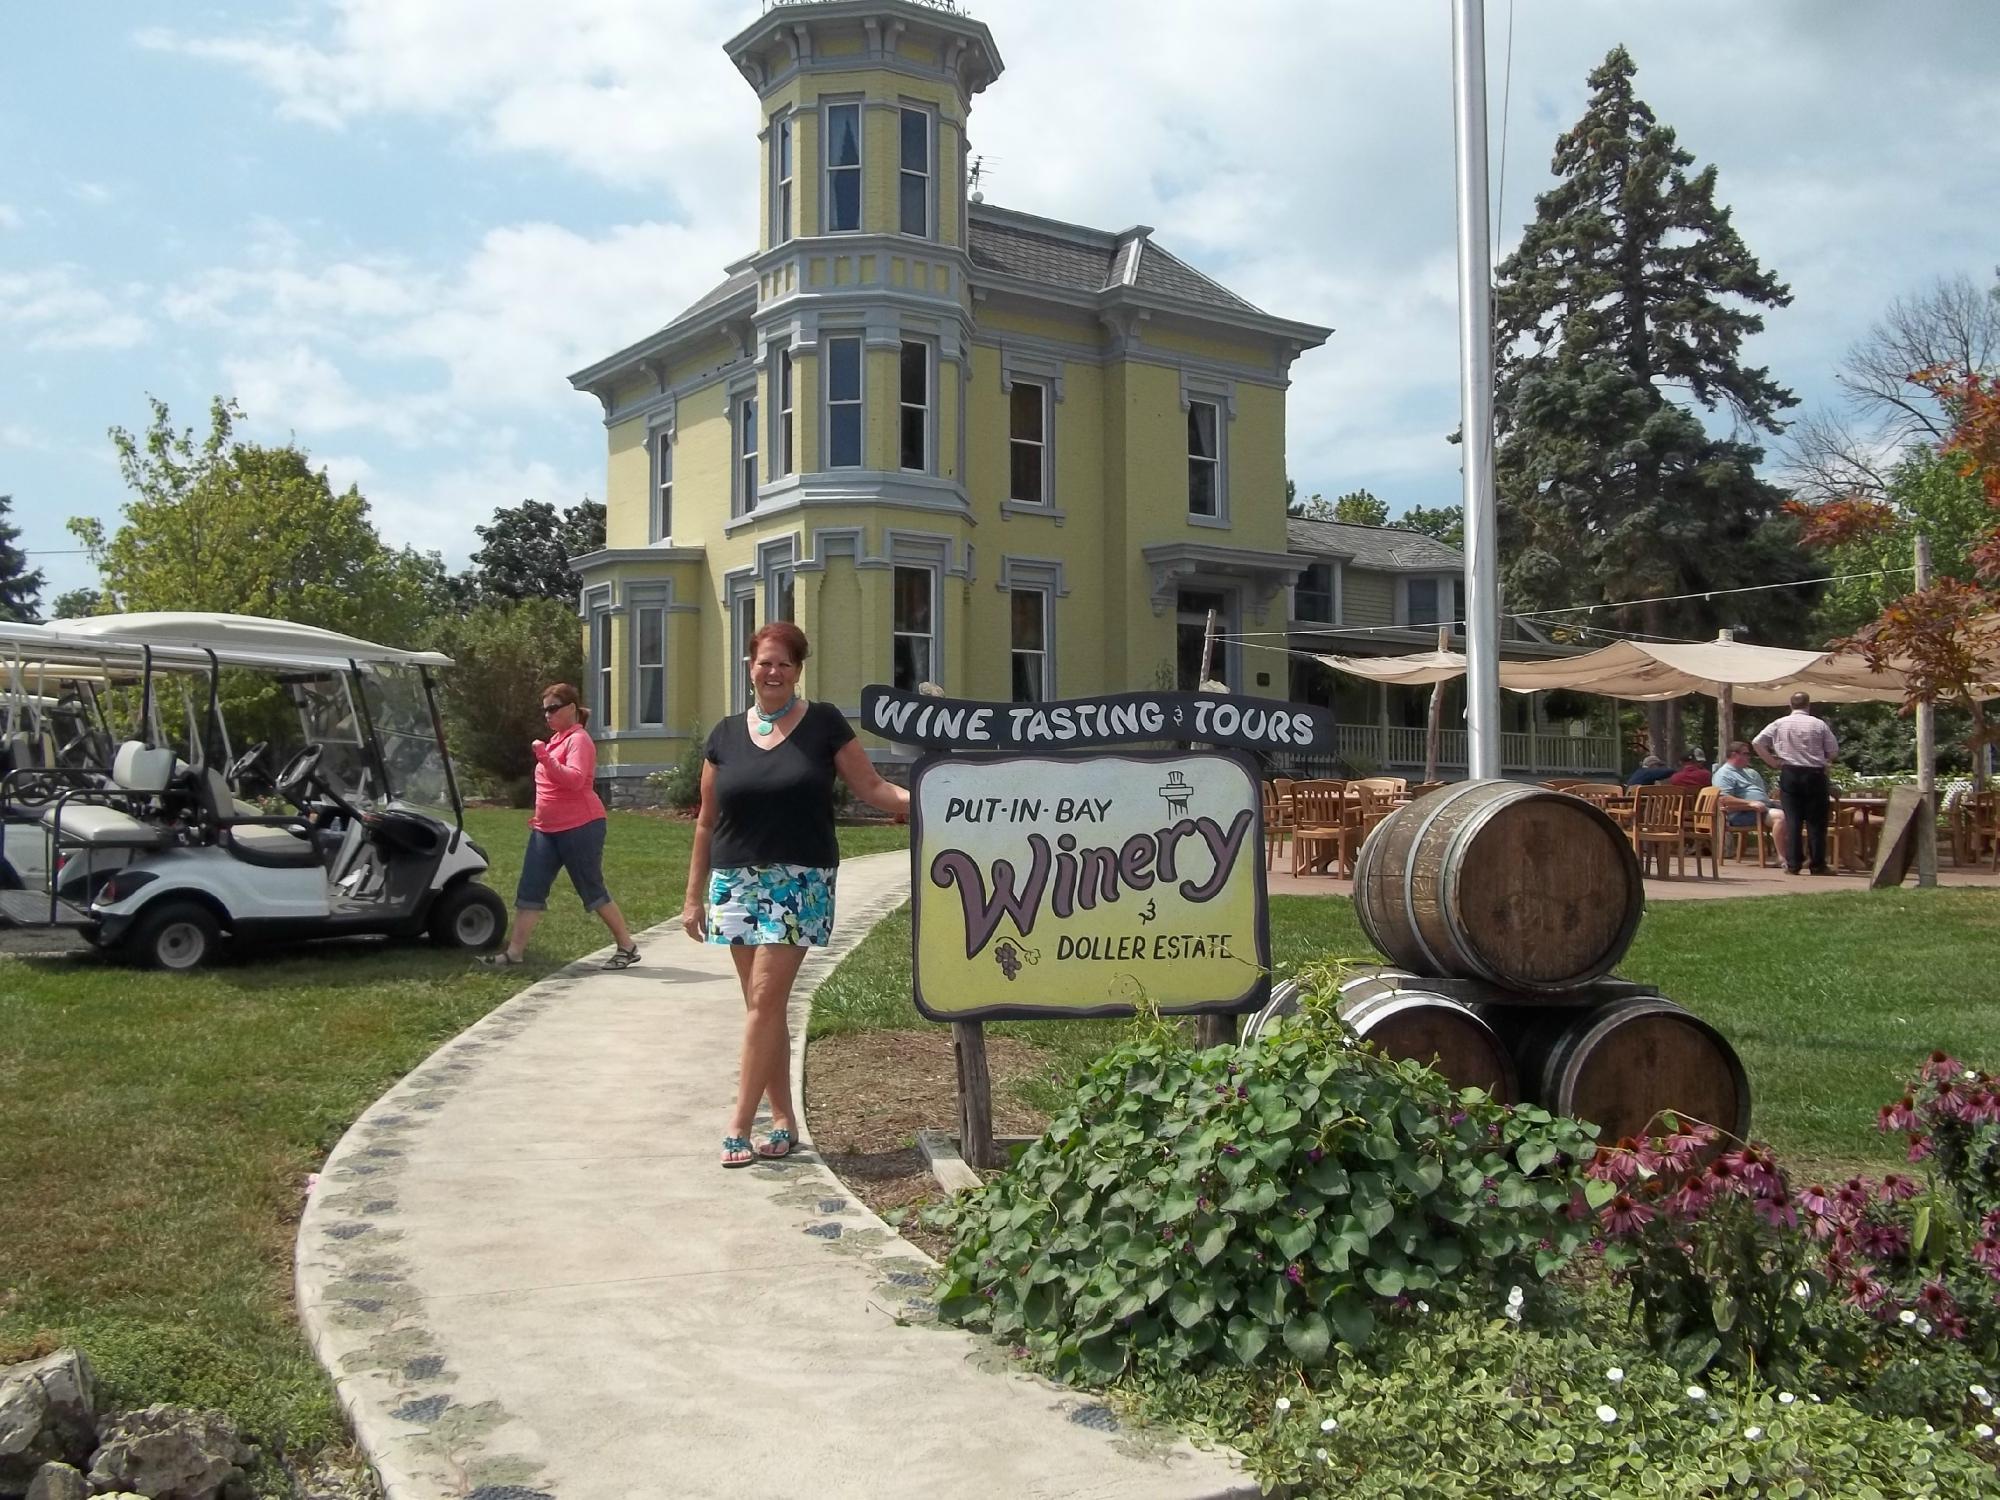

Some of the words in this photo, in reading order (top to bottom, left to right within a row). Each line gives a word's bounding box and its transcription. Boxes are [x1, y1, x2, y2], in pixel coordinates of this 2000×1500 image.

[874, 694, 994, 741] WINE
[1009, 701, 1165, 742] TASTING
[1194, 701, 1315, 745] TOURS
[931, 809, 1253, 960] Winery
[1056, 935, 1146, 961] DOLLER
[1153, 934, 1233, 961] ESTATE
